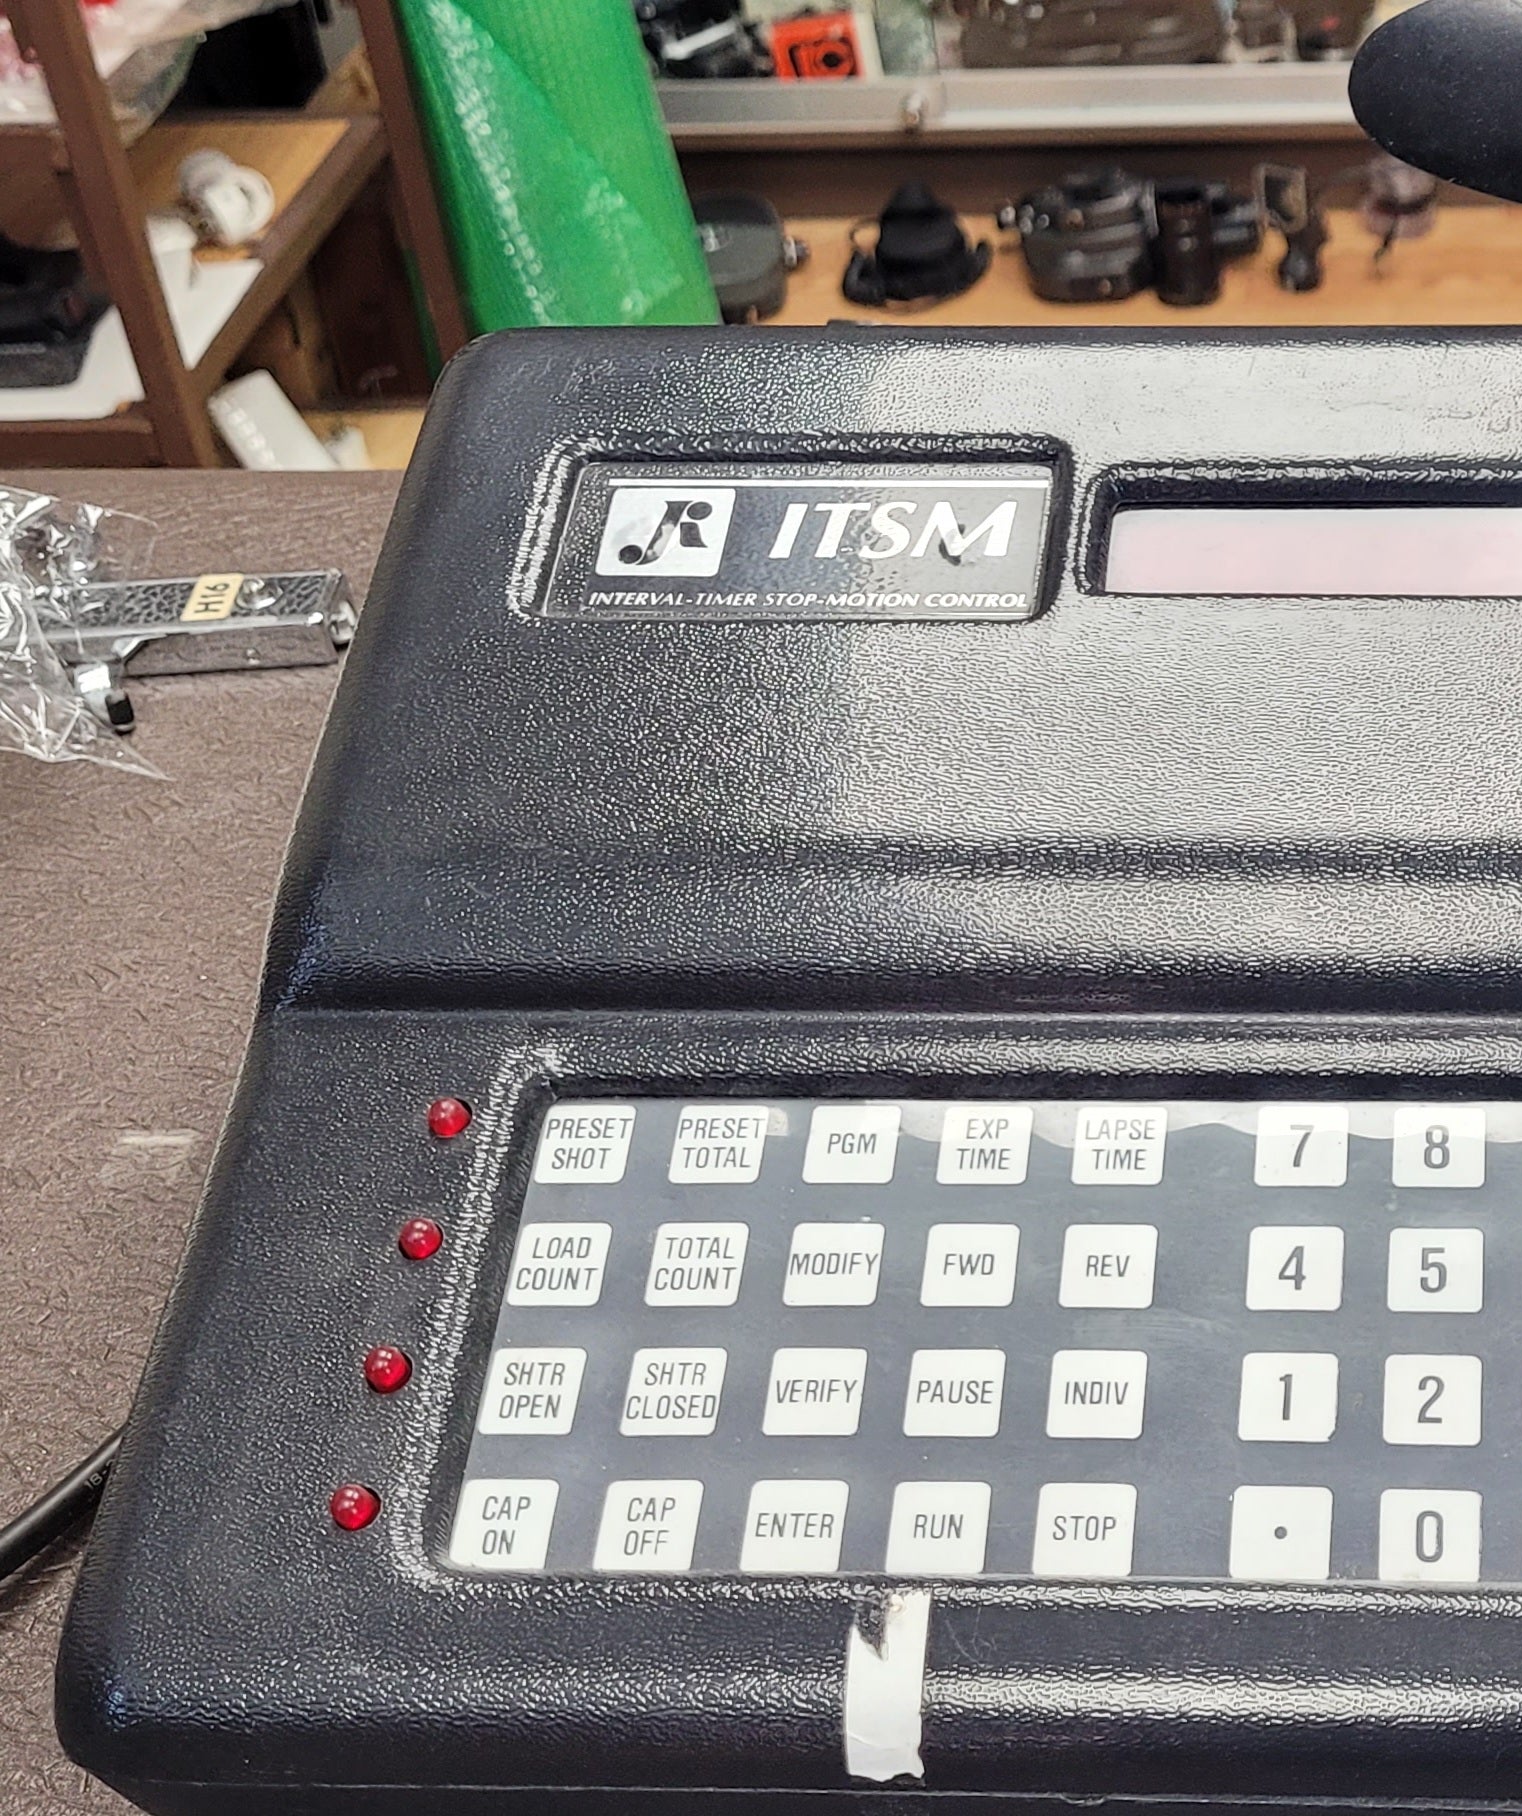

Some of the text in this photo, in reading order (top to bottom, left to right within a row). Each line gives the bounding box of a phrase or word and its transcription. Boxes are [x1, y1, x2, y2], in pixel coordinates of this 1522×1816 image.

[768, 501, 1017, 559] ITSM
[194, 582, 230, 613] H16
[589, 592, 1027, 608] INTERVAL-TIMER STOP-MOTION CONTROL
[545, 1117, 632, 1139] PRESET
[679, 1117, 765, 1140] PRESET
[966, 1119, 1010, 1140] EXP
[1084, 1118, 1156, 1140] LAPSE
[826, 1133, 876, 1154] PGM
[1290, 1125, 1314, 1167] 7
[1424, 1125, 1450, 1169] 8
[552, 1147, 611, 1170] SHOT
[682, 1147, 750, 1170] TOTAL
[956, 1148, 1010, 1170] TIME
[1092, 1149, 1146, 1171] TIME
[532, 1236, 590, 1259] LOAD
[666, 1236, 734, 1259] TOTAL
[790, 1252, 878, 1276] MODIFY
[943, 1253, 995, 1276] FWD
[1085, 1254, 1130, 1277] REV
[1279, 1246, 1306, 1290] 4
[1419, 1248, 1447, 1292] 5
[516, 1267, 598, 1291] COUNT
[655, 1267, 736, 1291] COUNT
[505, 1363, 564, 1386] SHTR
[645, 1363, 705, 1386] SHTR
[776, 1379, 857, 1403] VERIFY
[916, 1380, 993, 1404] PAUSE
[1065, 1381, 1128, 1405] INDIV
[1278, 1374, 1293, 1421] 1
[1417, 1375, 1442, 1422] 2
[499, 1395, 560, 1418] OPEN
[626, 1395, 716, 1419] CLOSED
[482, 1496, 530, 1520] CAP
[627, 1498, 675, 1521] CAP
[755, 1513, 834, 1538] ENTER
[912, 1514, 962, 1538] RUN
[1053, 1516, 1117, 1540] STOP
[1416, 1511, 1443, 1561] 0
[482, 1530, 515, 1554] ON
[624, 1531, 668, 1555] OFF
